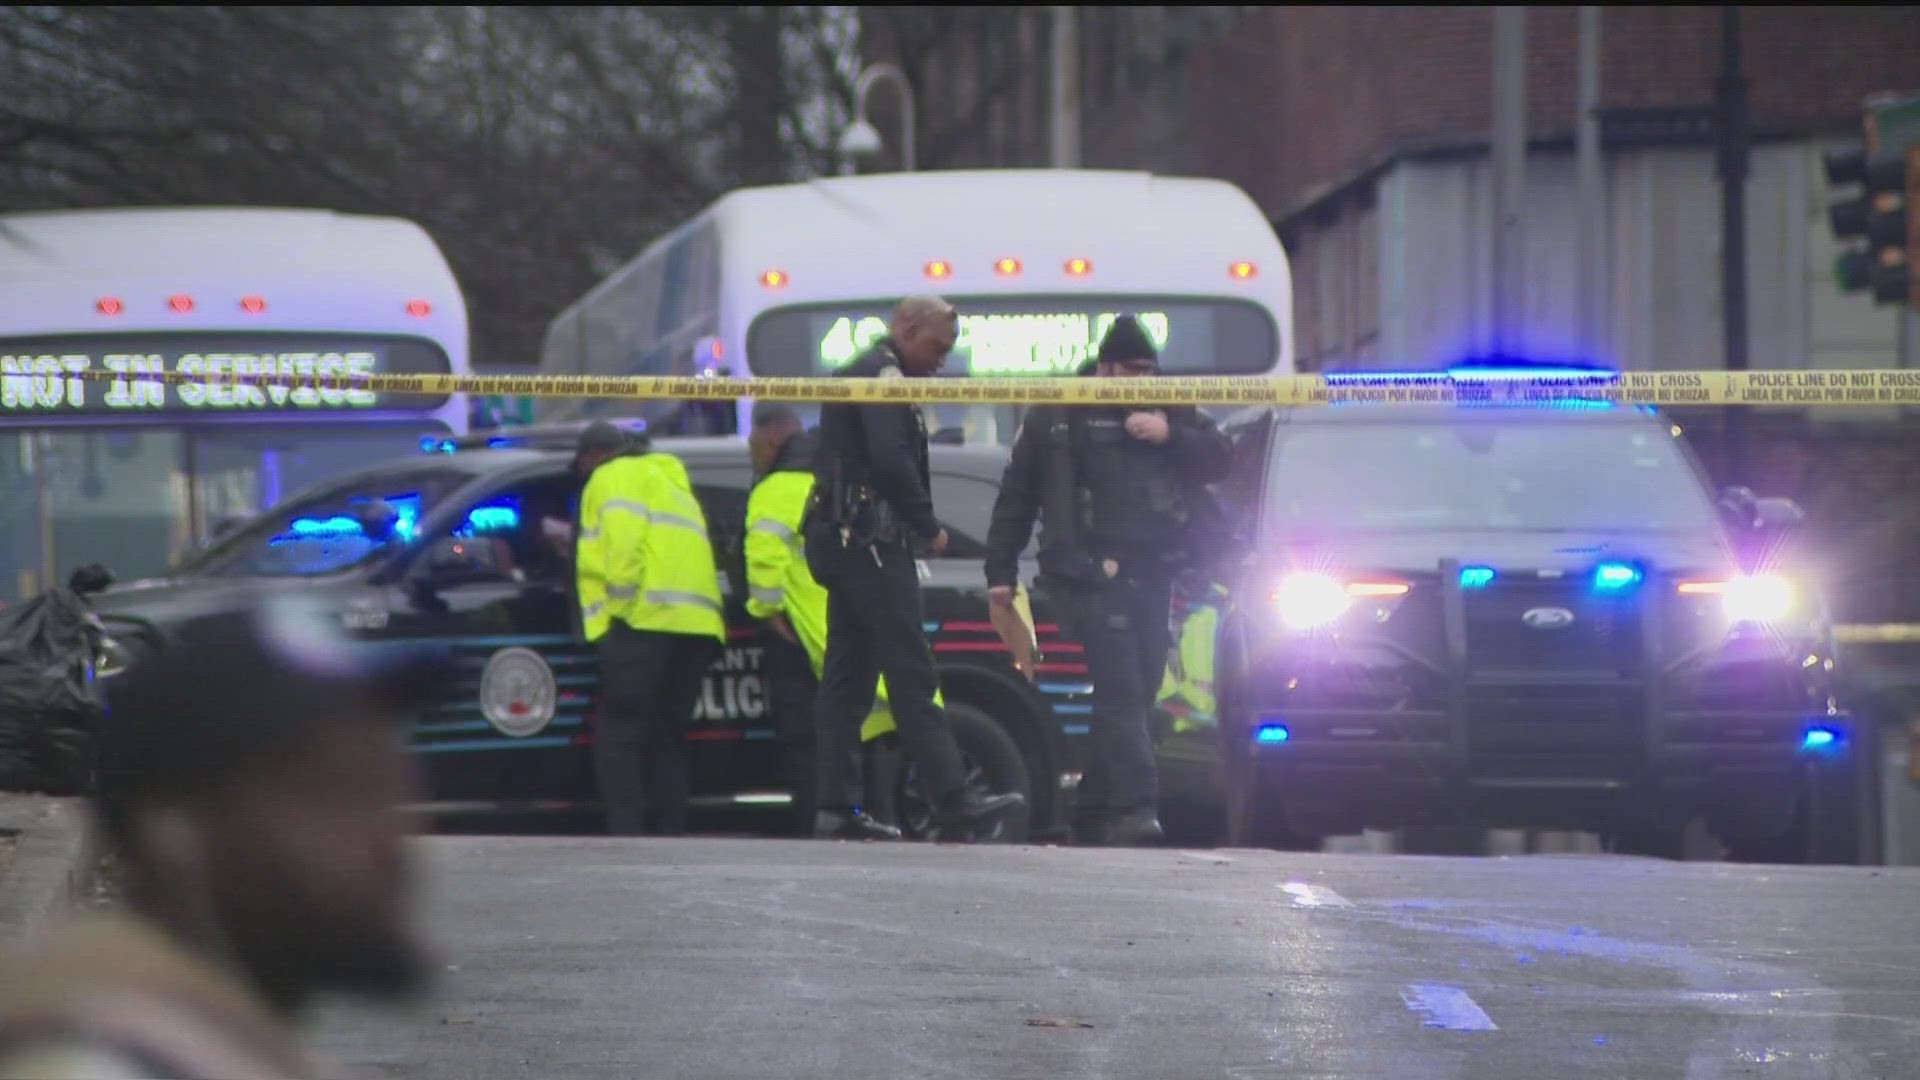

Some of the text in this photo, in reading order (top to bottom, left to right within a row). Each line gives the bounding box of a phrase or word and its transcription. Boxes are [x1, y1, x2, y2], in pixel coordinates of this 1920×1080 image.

[0, 352, 376, 408] NOT IN SERVICE
[1632, 375, 1655, 386] NOT
[1660, 375, 1702, 386] CROSS
[1749, 373, 1920, 386] POLICE LINE DO NOT CROSS
[454, 380, 638, 394] LINEA DE POLICIA POR FAVOR NO CRUZAR
[1195, 388, 1224, 400] FAVOR
[1226, 388, 1239, 400] NO
[1241, 388, 1277, 400] CRUZAR
[1308, 389, 1334, 400] LINEA
[1351, 389, 1386, 400] POLICIA
[1388, 389, 1407, 400] POR
[1409, 389, 1438, 400] FAVOR
[1441, 389, 1454, 400] NO
[1456, 389, 1493, 400] CRUZAR
[1605, 389, 1623, 400] POR
[1627, 389, 1655, 400] FAVOR
[1658, 389, 1671, 400] NO
[1673, 389, 1710, 400] CRUZAR
[1742, 388, 1920, 401] LINEA DE POLICIA POR FAVOR NO CRUZ
[693, 676, 770, 719] LIC
